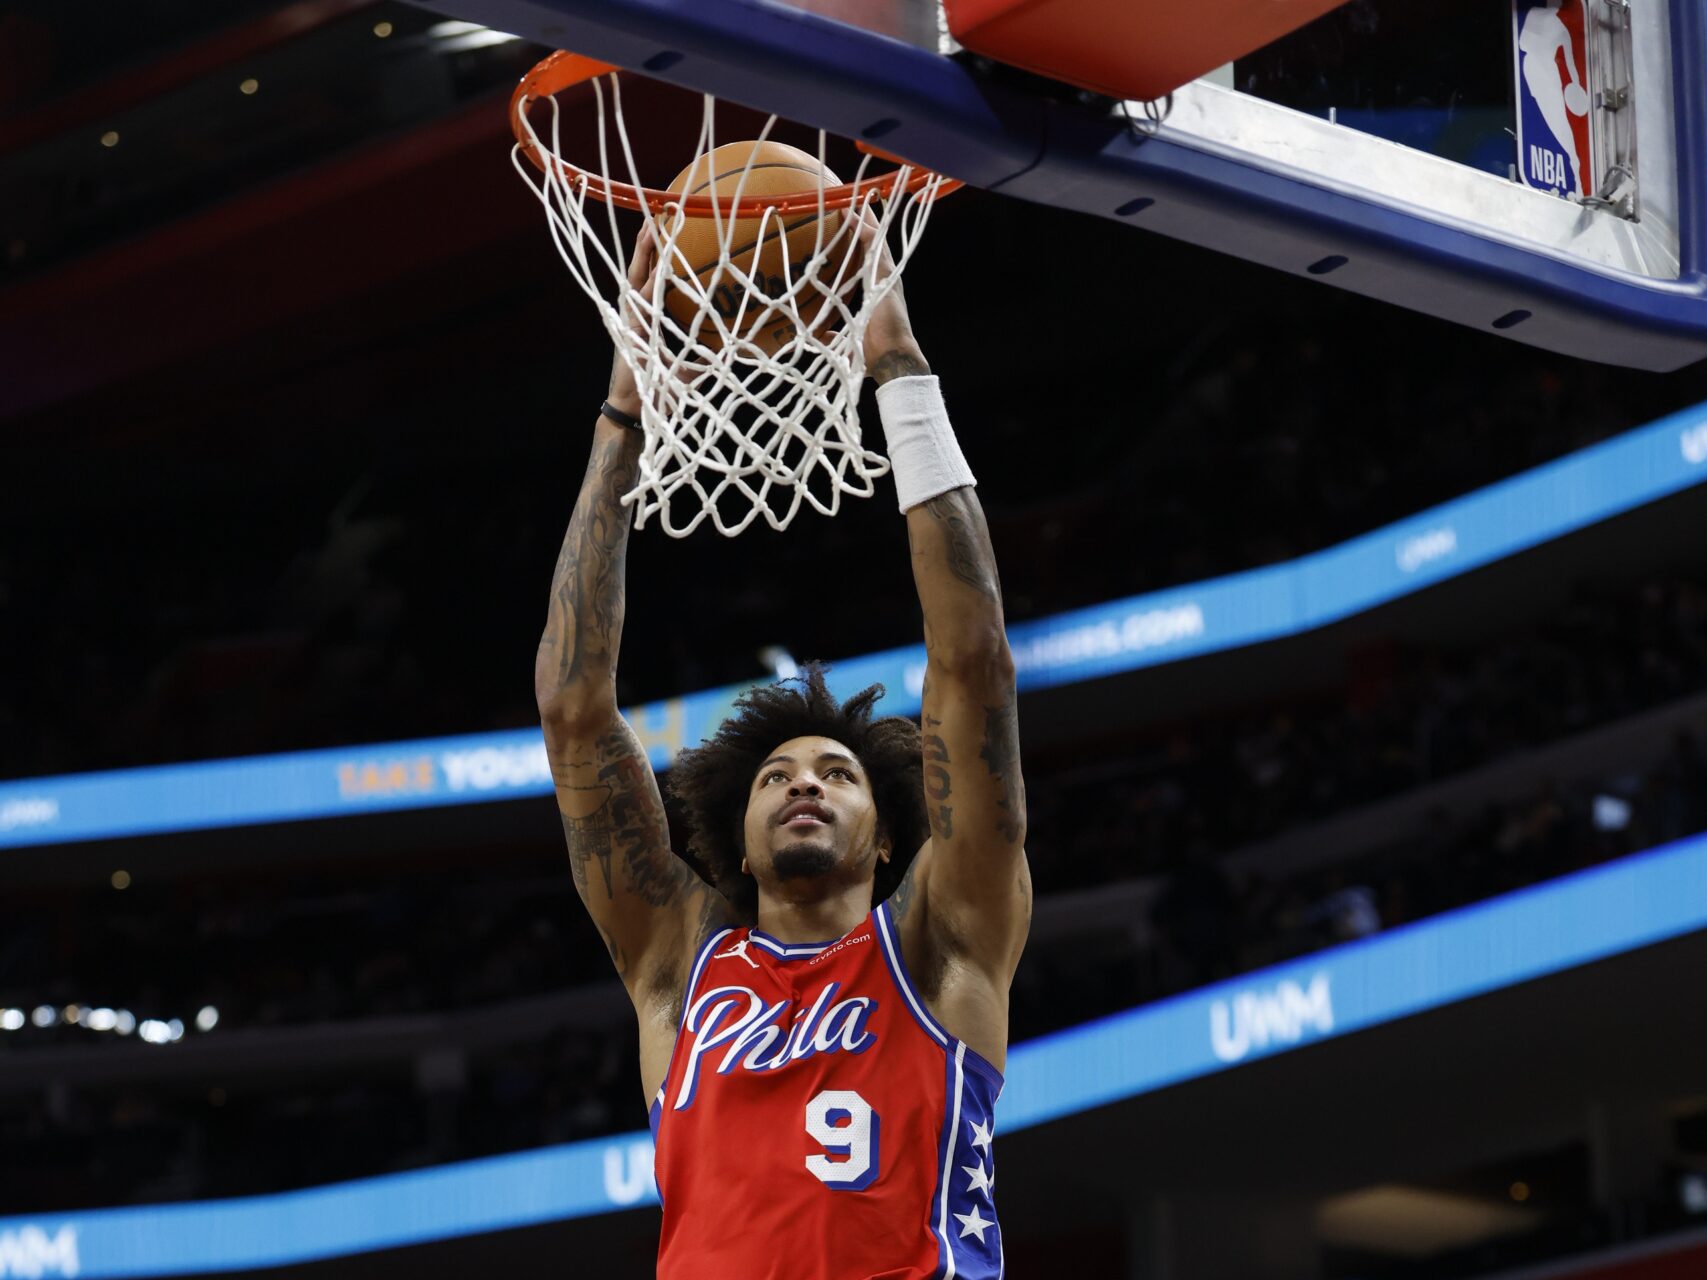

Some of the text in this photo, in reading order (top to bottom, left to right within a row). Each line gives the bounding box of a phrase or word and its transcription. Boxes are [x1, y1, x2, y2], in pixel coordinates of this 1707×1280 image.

[1530, 144, 1567, 190] NBA
[809, 933, 871, 966] crypto.com
[674, 980, 879, 1112] Phila
[1209, 972, 1334, 1062] UWM
[805, 1090, 881, 1192] 9
